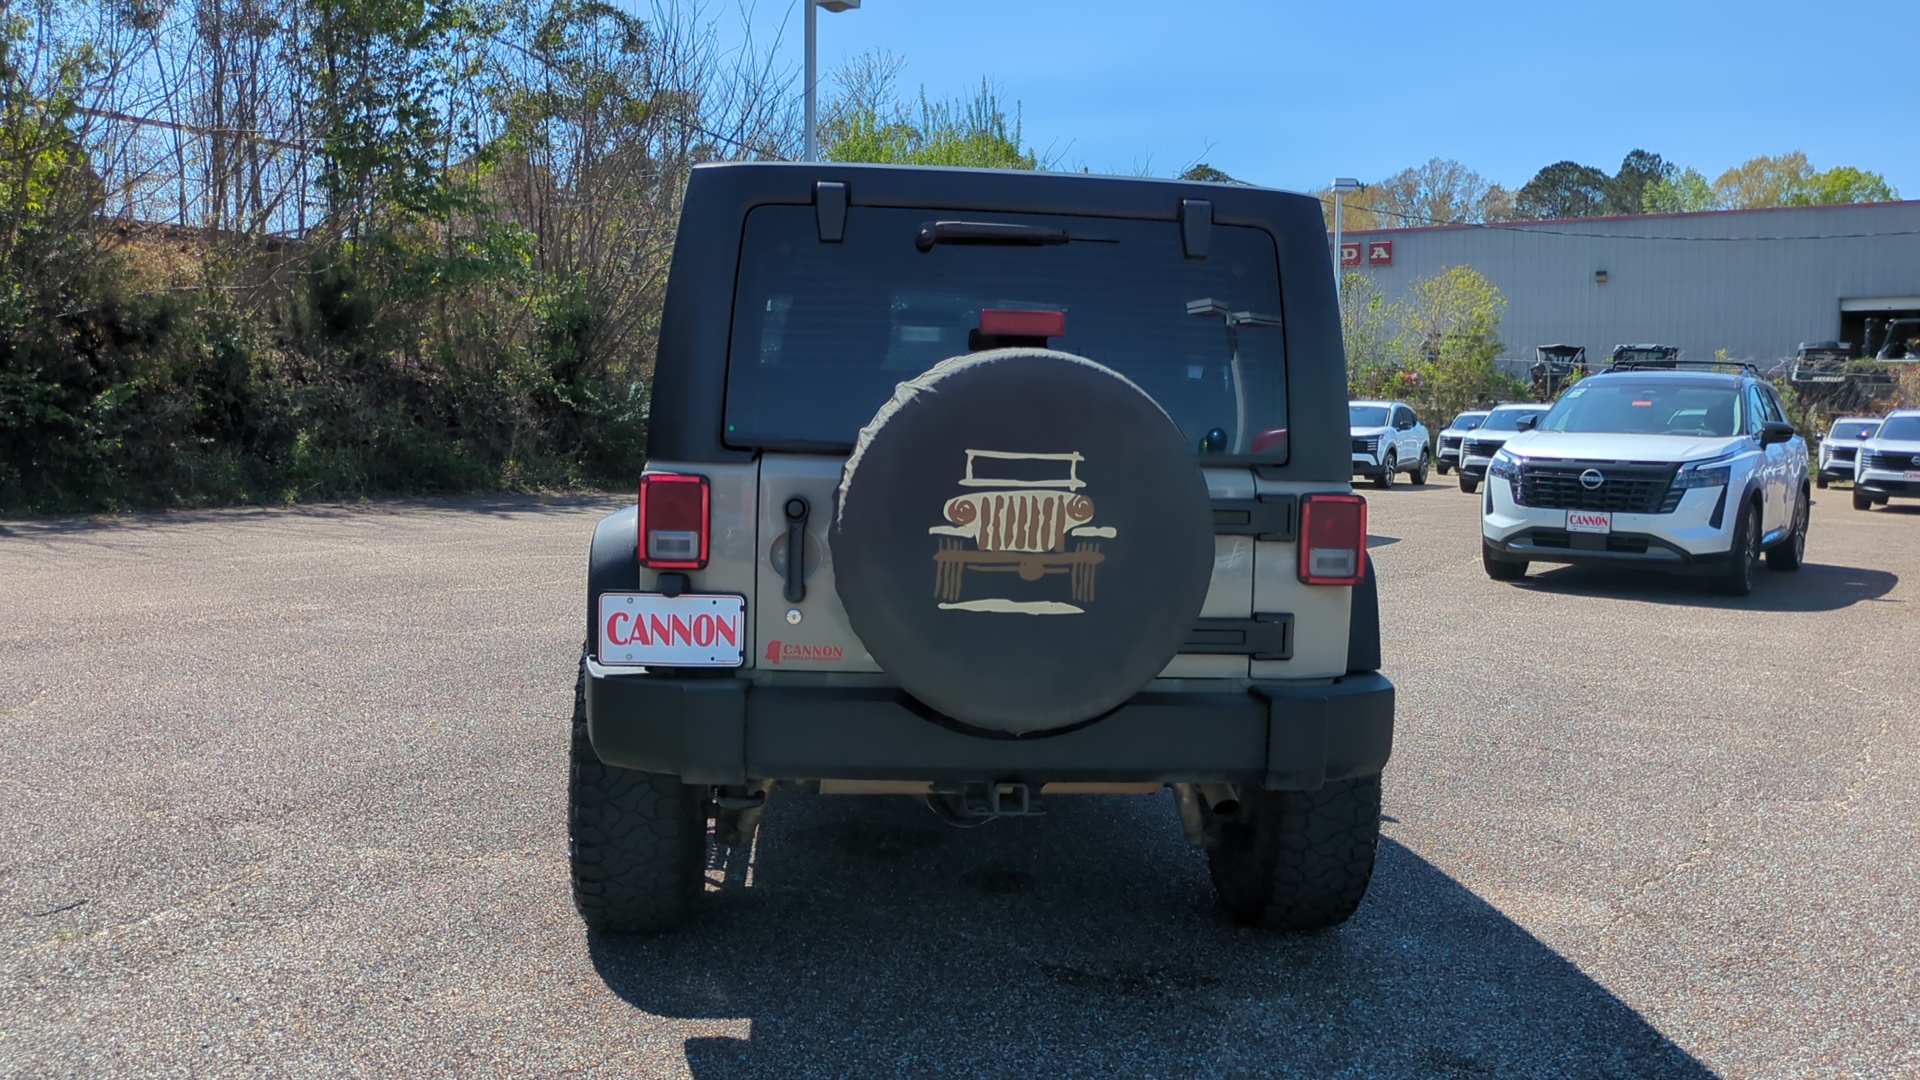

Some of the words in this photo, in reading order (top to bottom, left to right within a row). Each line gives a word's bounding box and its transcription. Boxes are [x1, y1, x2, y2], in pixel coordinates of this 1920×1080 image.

[1569, 514, 1608, 527] CANNON
[606, 611, 737, 648] CANNON
[783, 644, 843, 657] CANNON
